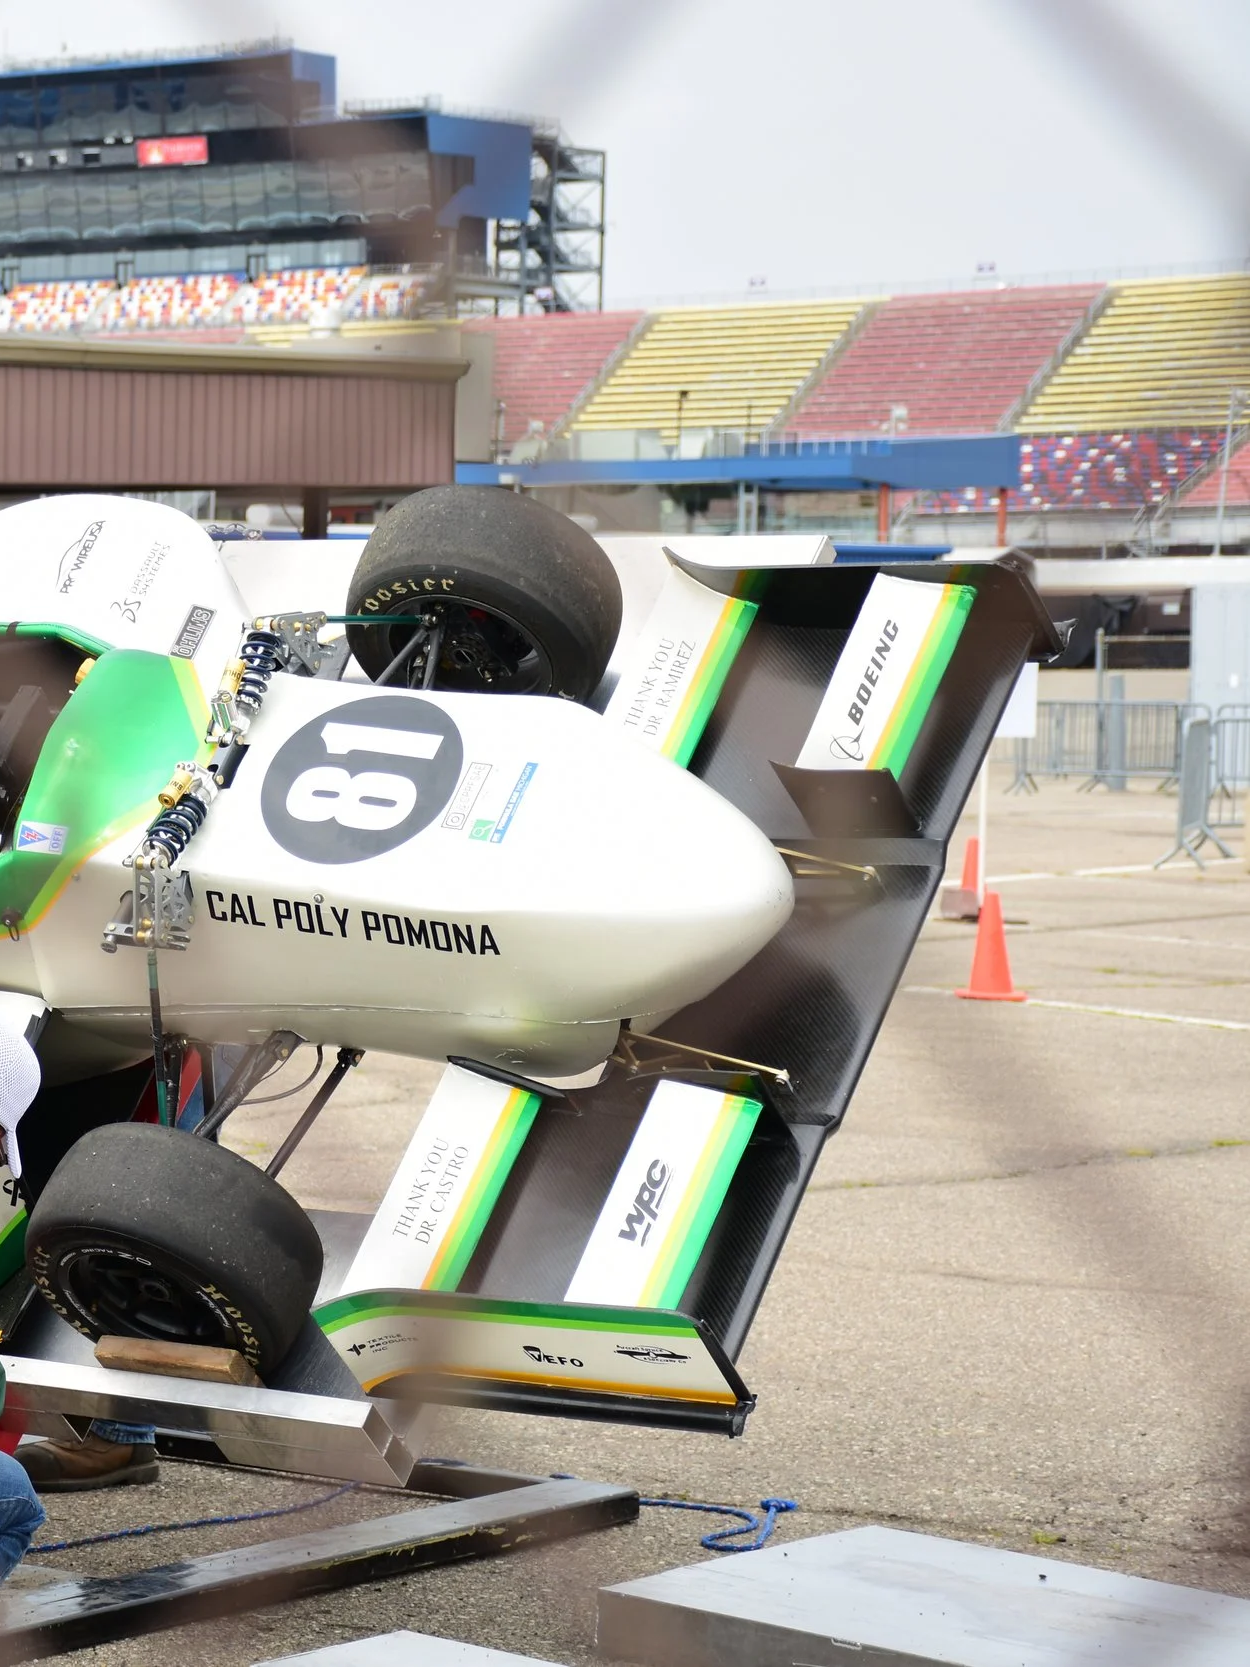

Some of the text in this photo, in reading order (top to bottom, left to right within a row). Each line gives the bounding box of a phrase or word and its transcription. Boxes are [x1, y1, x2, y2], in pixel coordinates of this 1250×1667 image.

[623, 638, 675, 725] THANK YOU
[656, 640, 697, 708] RAMIREZ
[847, 619, 899, 726] BOEING
[285, 721, 445, 831] 81
[51, 828, 64, 849] OFF
[206, 890, 501, 956] CAL POLY POMONA
[392, 1137, 449, 1237] THANK YOU
[415, 1146, 469, 1244] DR. CASTRO
[367, 1333, 403, 1345] TEXTILE
[369, 1337, 420, 1349] PRODUCTS
